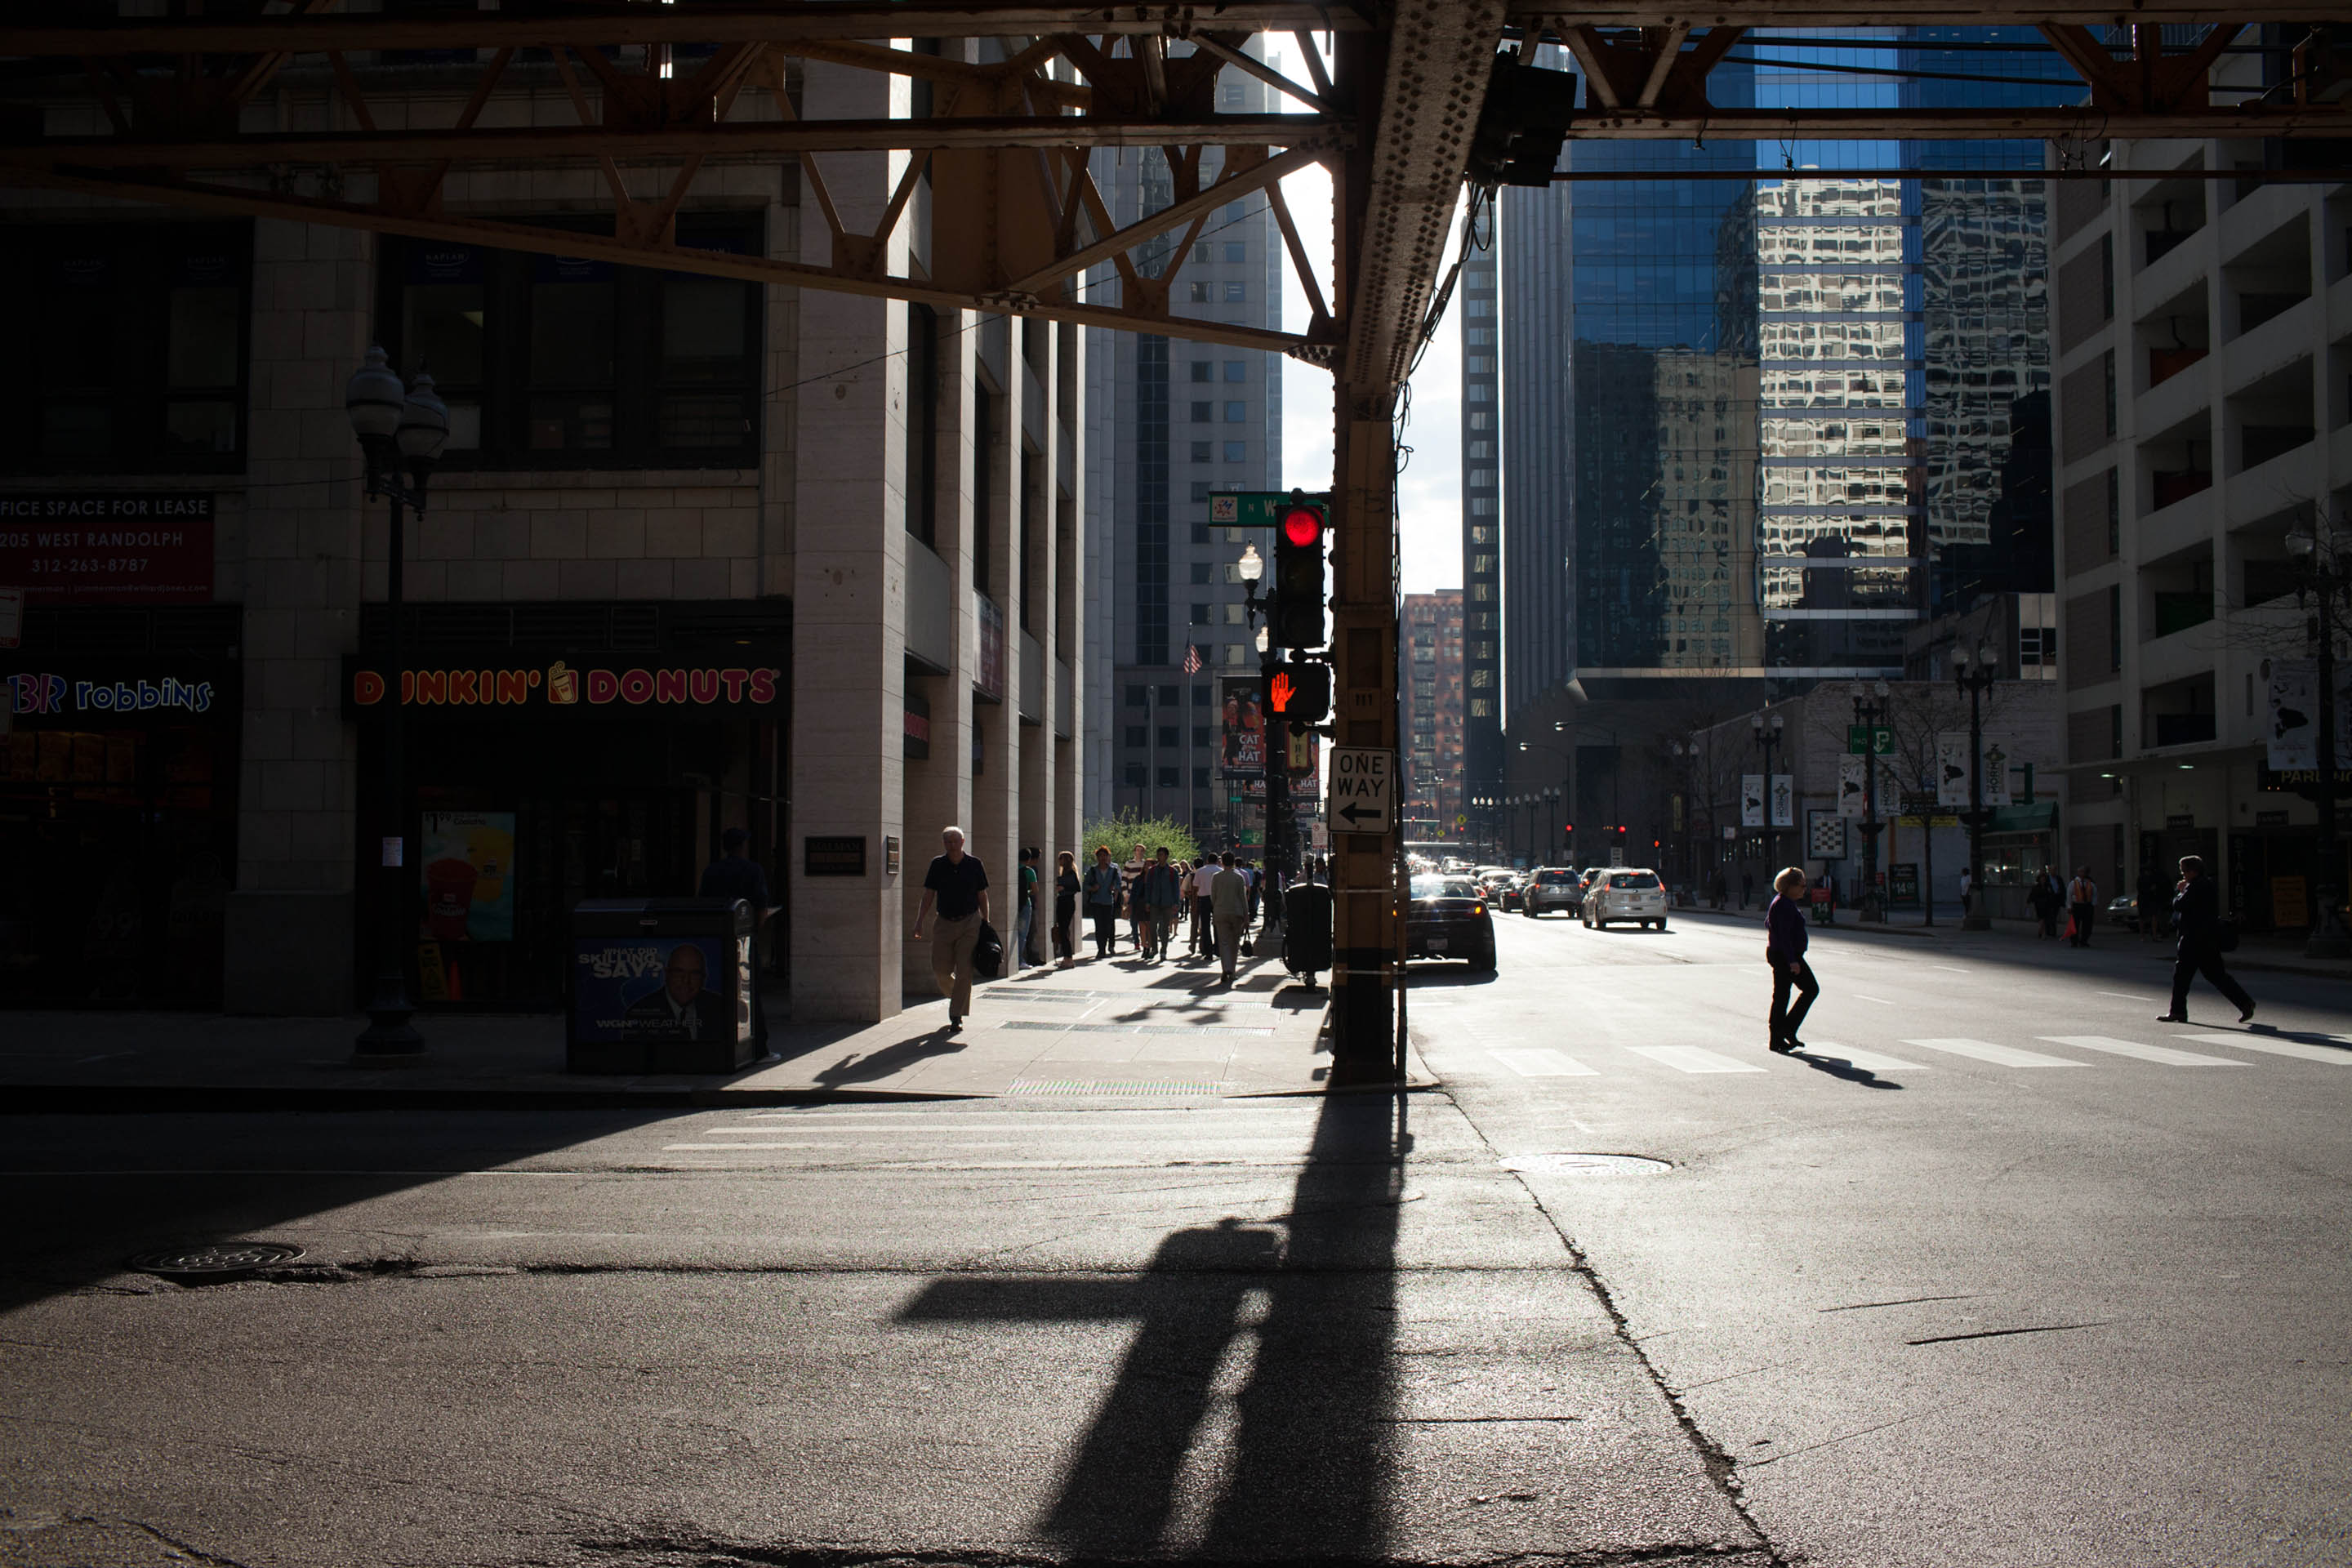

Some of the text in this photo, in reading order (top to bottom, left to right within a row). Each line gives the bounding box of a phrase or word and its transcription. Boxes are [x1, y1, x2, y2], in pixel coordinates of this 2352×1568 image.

[46, 500, 105, 516] SPACE
[111, 500, 149, 515] FOR
[155, 500, 208, 515] LEASE
[0, 532, 183, 547] 205 WEST RANDOLPH
[588, 668, 777, 705] DONUTS
[1239, 734, 1260, 745] CAT
[1238, 751, 1261, 762] HAT
[1339, 755, 1384, 775] ONE
[1254, 779, 1266, 788] HA
[1300, 779, 1317, 788] HAT
[2281, 771, 2352, 784] PARNG
[1337, 777, 1384, 798] WAY
[577, 954, 657, 964] SKILLING
[594, 962, 665, 979] SAY?
[639, 1018, 704, 1027] WEATHER
